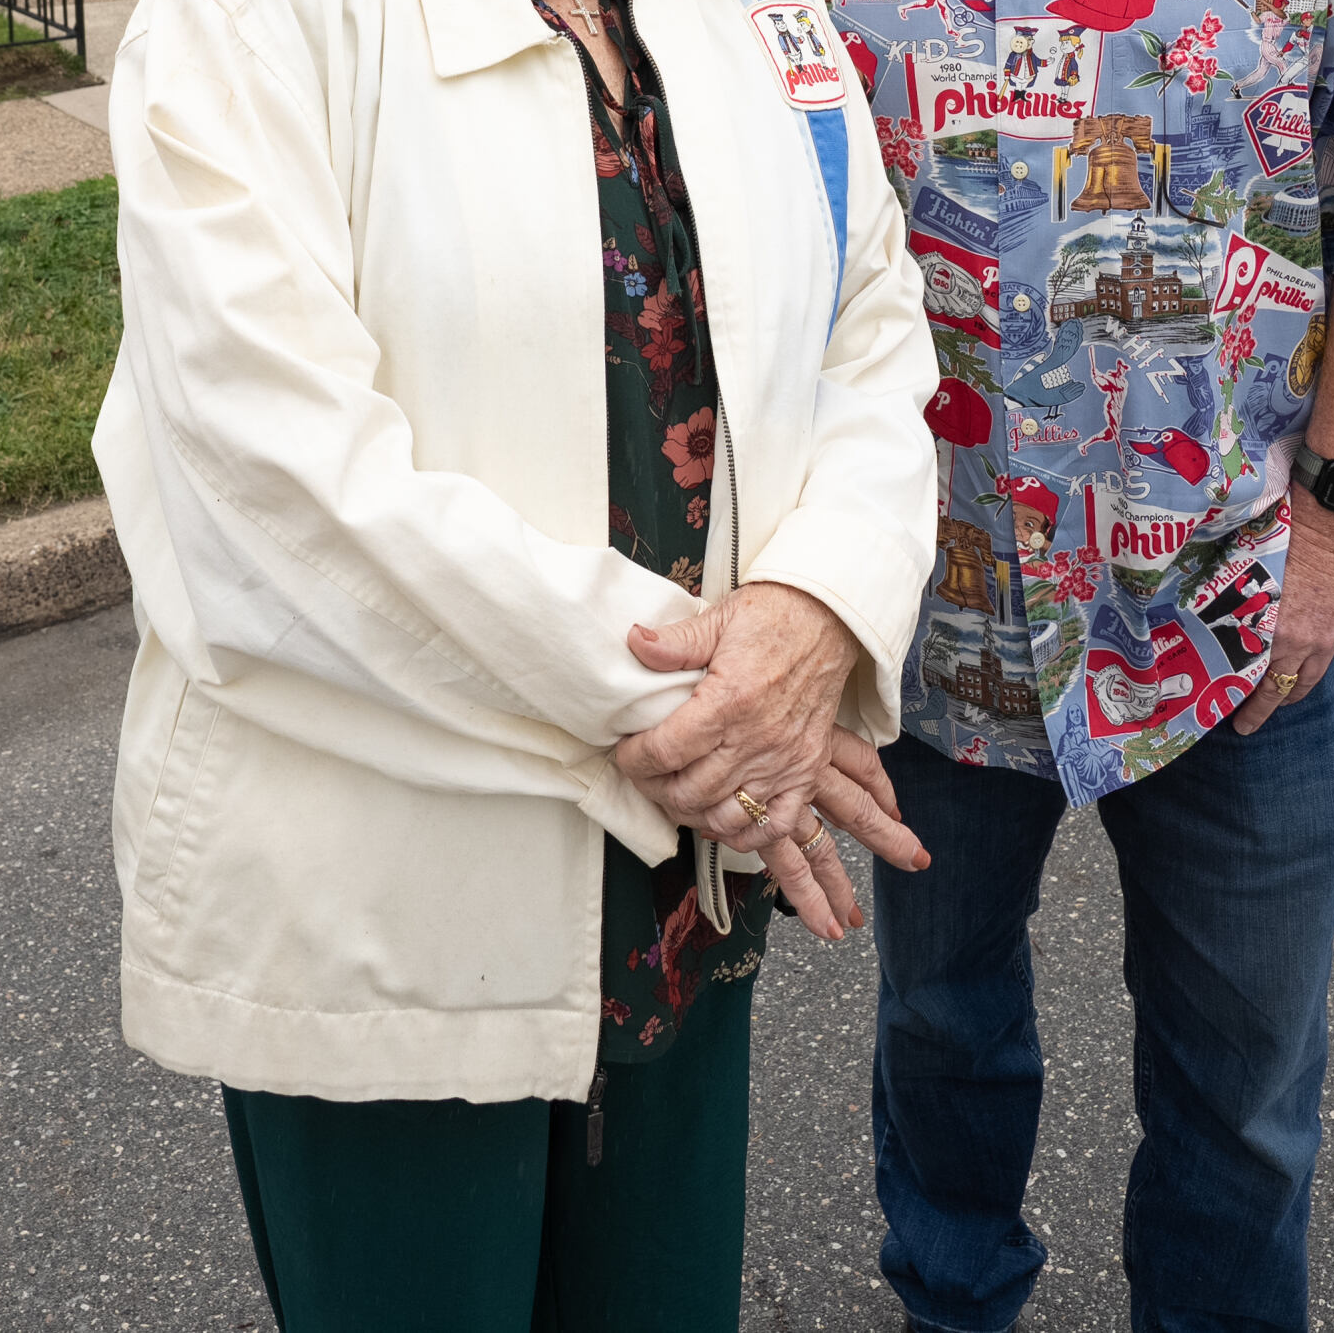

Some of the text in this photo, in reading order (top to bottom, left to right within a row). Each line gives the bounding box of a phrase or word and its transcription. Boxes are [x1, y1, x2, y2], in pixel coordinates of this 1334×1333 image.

[884, 27, 987, 64] KIDS
[939, 63, 962, 74] 1980
[931, 73, 957, 83] World
[932, 277, 950, 290] 1950
[1105, 316, 1188, 404] WHIZ
[935, 391, 951, 411] P
[1009, 413, 1024, 427] Th
[1065, 470, 1152, 501] KIDS
[1124, 511, 1175, 523] Champions
